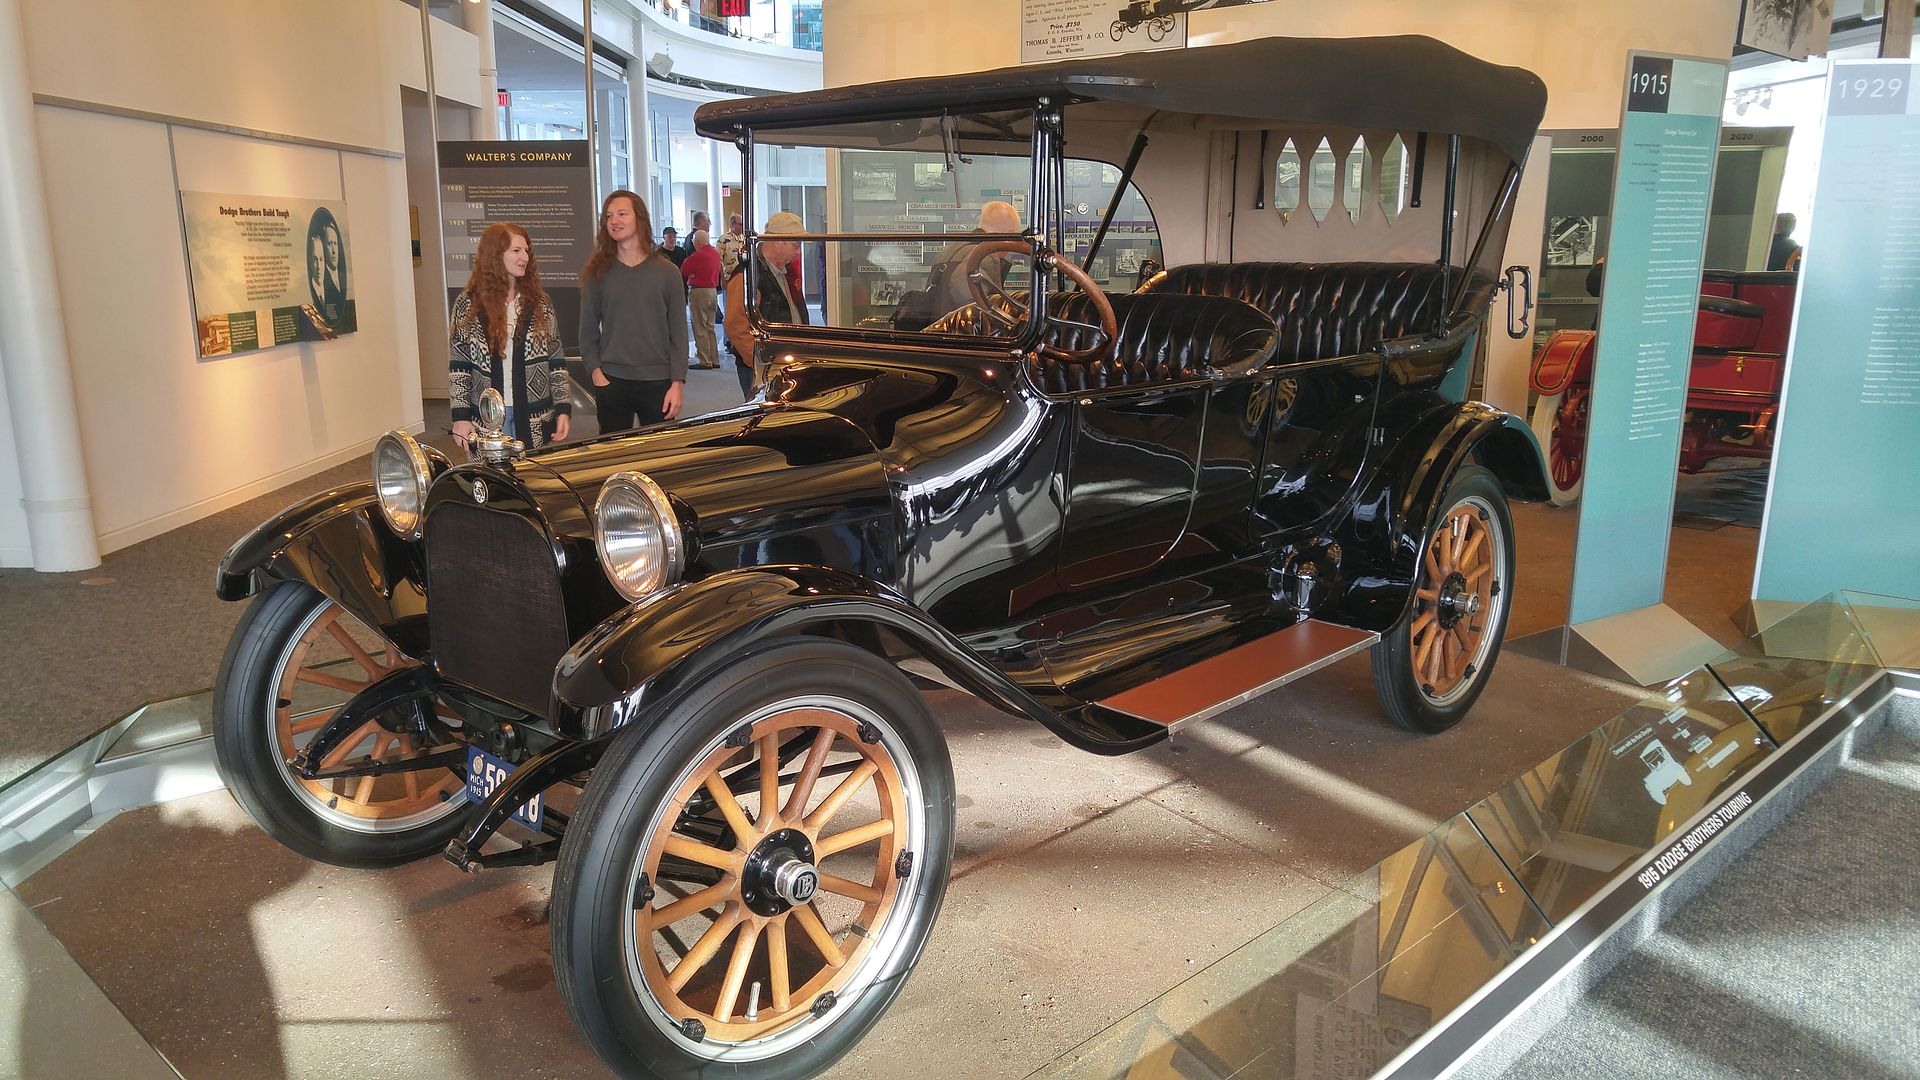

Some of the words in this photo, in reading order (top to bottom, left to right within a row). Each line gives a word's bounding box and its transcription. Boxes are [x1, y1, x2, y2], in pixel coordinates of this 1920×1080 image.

[1060, 35, 1083, 43] JEFFERY
[1632, 73, 1668, 96] 1915
[1840, 78, 1902, 98] 1929
[466, 153, 516, 161] WALTER'S
[520, 153, 572, 161] COMPANY
[220, 206, 238, 217] Dodge
[239, 208, 262, 216] Brothers
[263, 208, 275, 216] Build
[276, 209, 290, 219] Tough
[470, 774, 484, 786] MICH
[471, 785, 481, 796] 1915
[1638, 866, 1660, 889] 1915
[1654, 843, 1688, 875] DODGE
[1682, 814, 1724, 852] BROTHERS
[1717, 791, 1752, 822] TOURING
